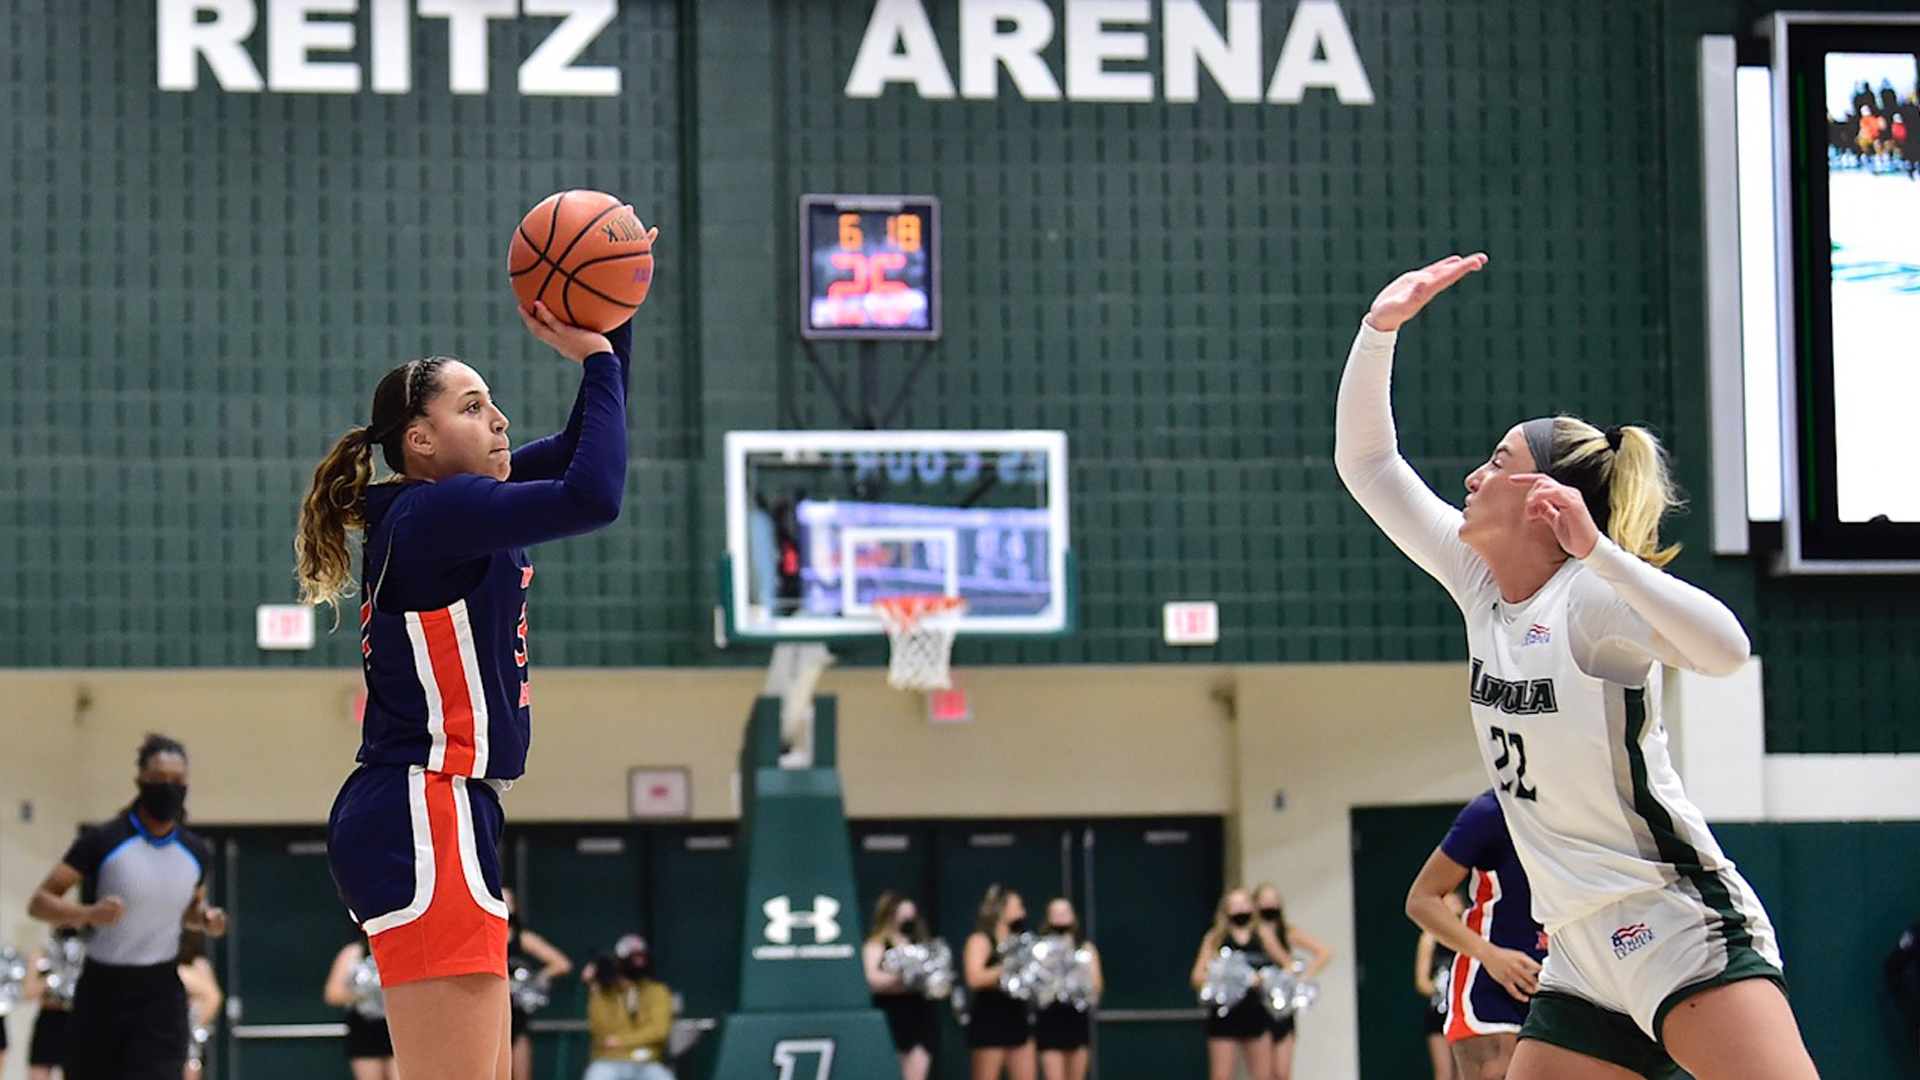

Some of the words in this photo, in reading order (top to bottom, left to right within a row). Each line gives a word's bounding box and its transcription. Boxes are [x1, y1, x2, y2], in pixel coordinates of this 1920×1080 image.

[157, 0, 622, 96] REITZ
[844, 0, 1374, 104] ARENA
[1490, 726, 1537, 802] 22
